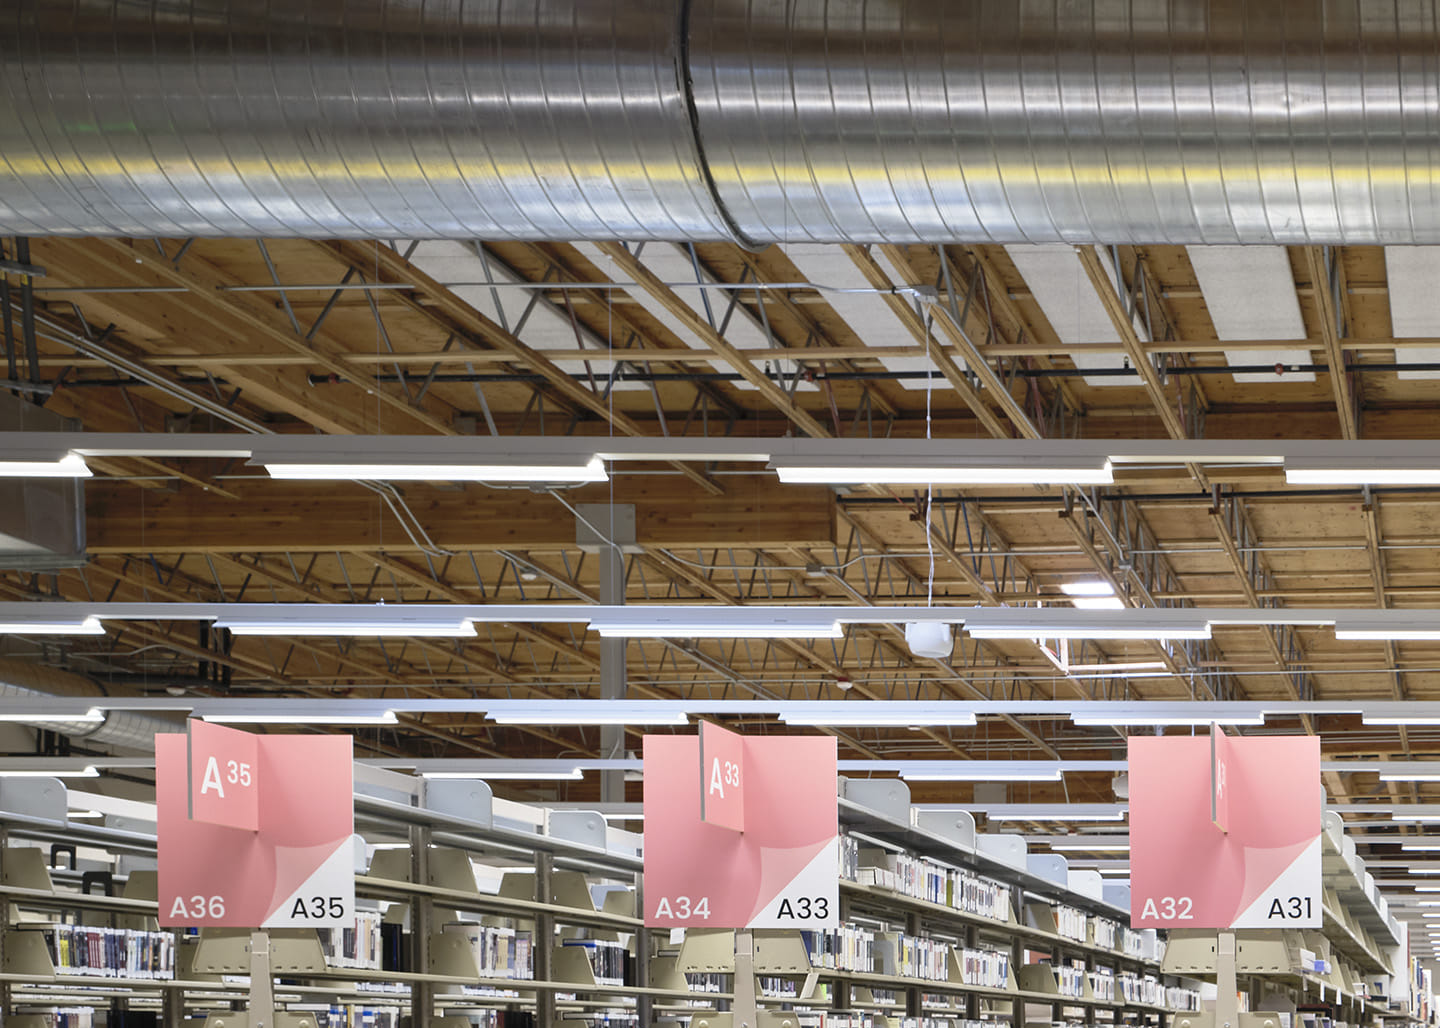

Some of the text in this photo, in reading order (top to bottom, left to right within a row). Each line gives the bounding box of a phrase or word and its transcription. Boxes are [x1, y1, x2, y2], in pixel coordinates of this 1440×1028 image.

[169, 895, 226, 919] A36
[290, 895, 344, 919] A35
[655, 896, 711, 920] A34
[777, 895, 830, 920] A33
[1141, 897, 1194, 920] A32
[1268, 897, 1312, 919] A31
